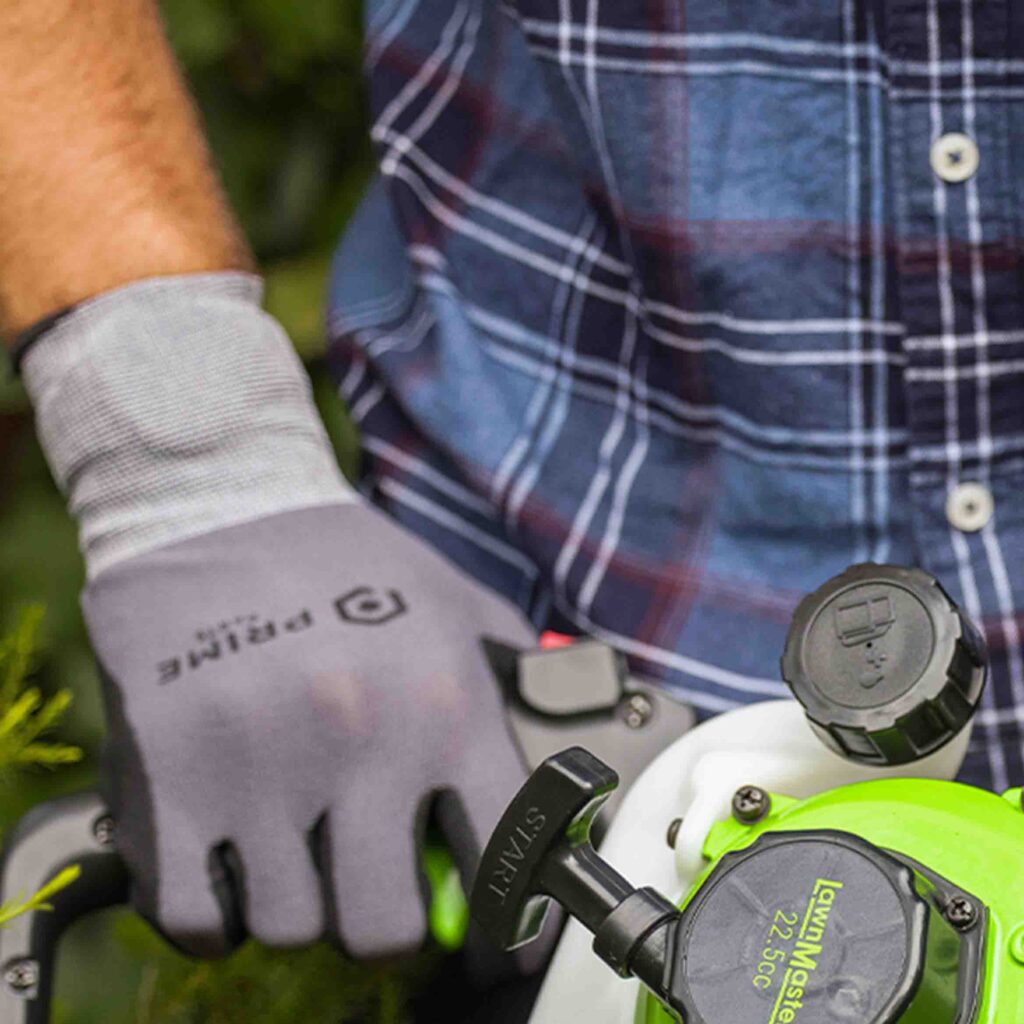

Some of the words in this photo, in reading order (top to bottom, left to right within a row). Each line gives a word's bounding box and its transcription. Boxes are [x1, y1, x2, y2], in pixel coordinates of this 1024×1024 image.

[156, 608, 314, 686] PRIME
[488, 806, 547, 905] START
[752, 909, 799, 990] 22.5cc
